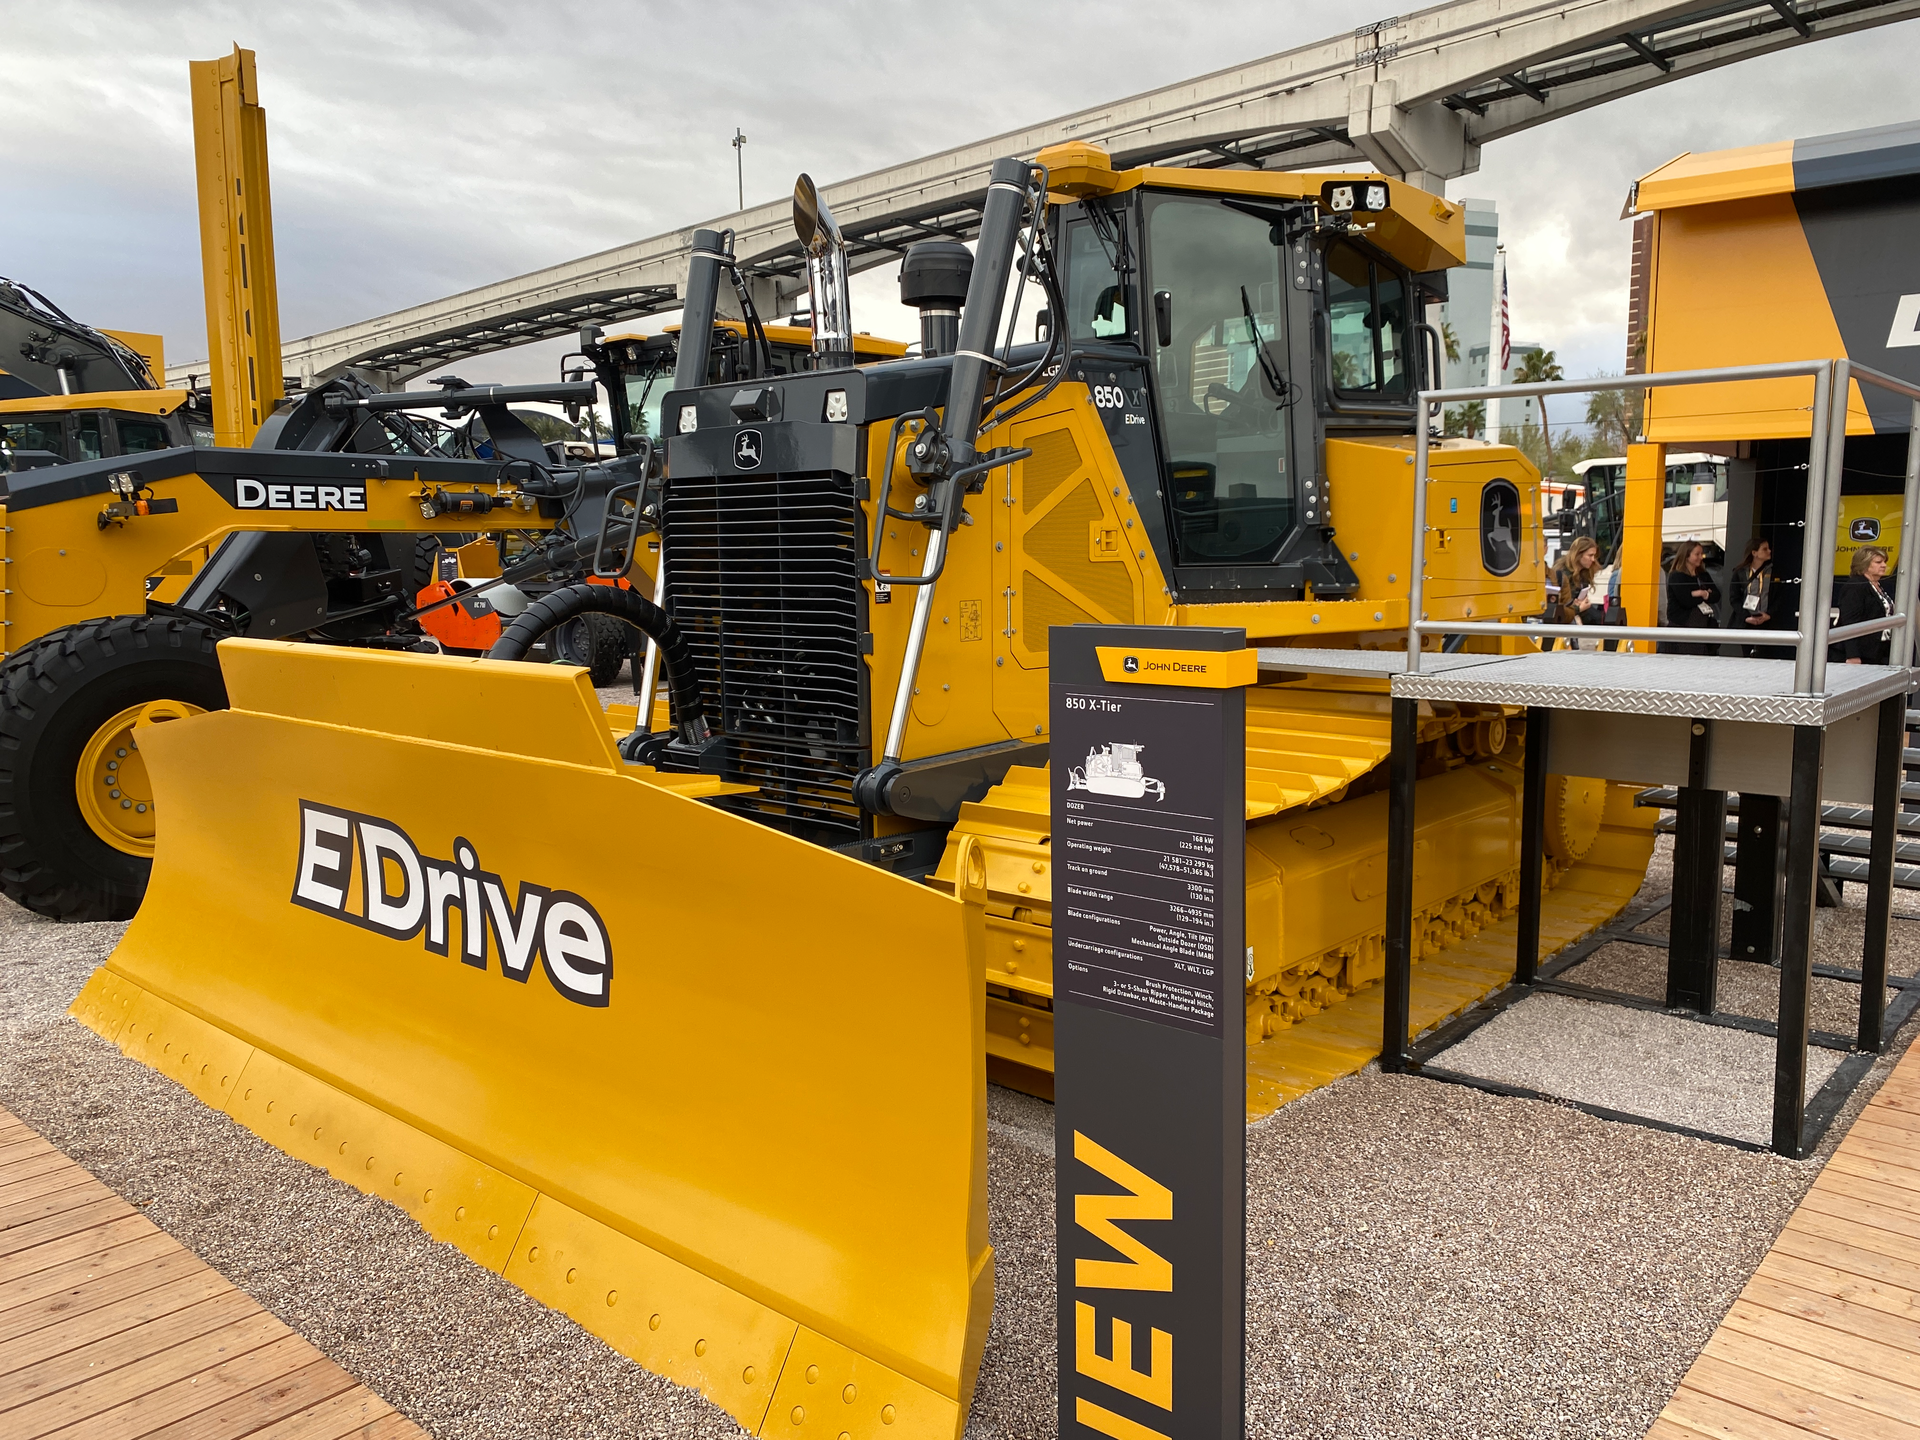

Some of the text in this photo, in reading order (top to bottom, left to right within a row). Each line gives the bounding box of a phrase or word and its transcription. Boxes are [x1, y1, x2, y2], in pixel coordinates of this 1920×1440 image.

[1094, 385, 1124, 408] 850
[1125, 414, 1146, 425] EDrive
[236, 479, 365, 509] DEERE
[1143, 661, 1207, 673] JOHN DEERE
[1066, 697, 1122, 713] 850 X-Tier
[1067, 802, 1085, 810] DOZER
[1192, 835, 1203, 843] 168
[1067, 841, 1111, 853] Operating weight
[1180, 841, 1192, 849] (225
[1205, 845, 1214, 853] hp)
[1067, 864, 1081, 872] Track
[1089, 868, 1107, 876] ground
[1194, 860, 1205, 868] 299
[1207, 862, 1214, 870] kg
[1204, 868, 1214, 878] lb.)
[1068, 887, 1113, 901] Blade width range
[1187, 884, 1202, 893] 3300
[297, 808, 606, 995] EDrive
[1190, 892, 1214, 903] (130 in.)
[1068, 910, 1120, 925] Blade configurations
[1203, 911, 1214, 919] mm
[1204, 918, 1214, 928] in.)
[1150, 926, 1214, 944] Power, Angle, Tilt (PAT)
[1132, 937, 1214, 960] Mechanical Angle Blade (MAB)
[1158, 935, 1214, 952] Outside Dozer (OSD)
[1068, 940, 1143, 962] Undercarriage configurations
[1068, 963, 1088, 972] Options
[1174, 962, 1214, 976] XLT, WLT, LGP
[1114, 980, 1120, 988] 3-
[1128, 984, 1150, 994] 5-Shank
[1151, 988, 1170, 999] Ripper,
[1171, 992, 1196, 1006] Retrieval
[1196, 998, 1214, 1010] Hitch,
[1146, 980, 1214, 1002] Brush Protection, Winch,
[1102, 986, 1214, 1018] Rigid Drawbar, or Waste-Handler Package
[1073, 1129, 1173, 1440] EW
